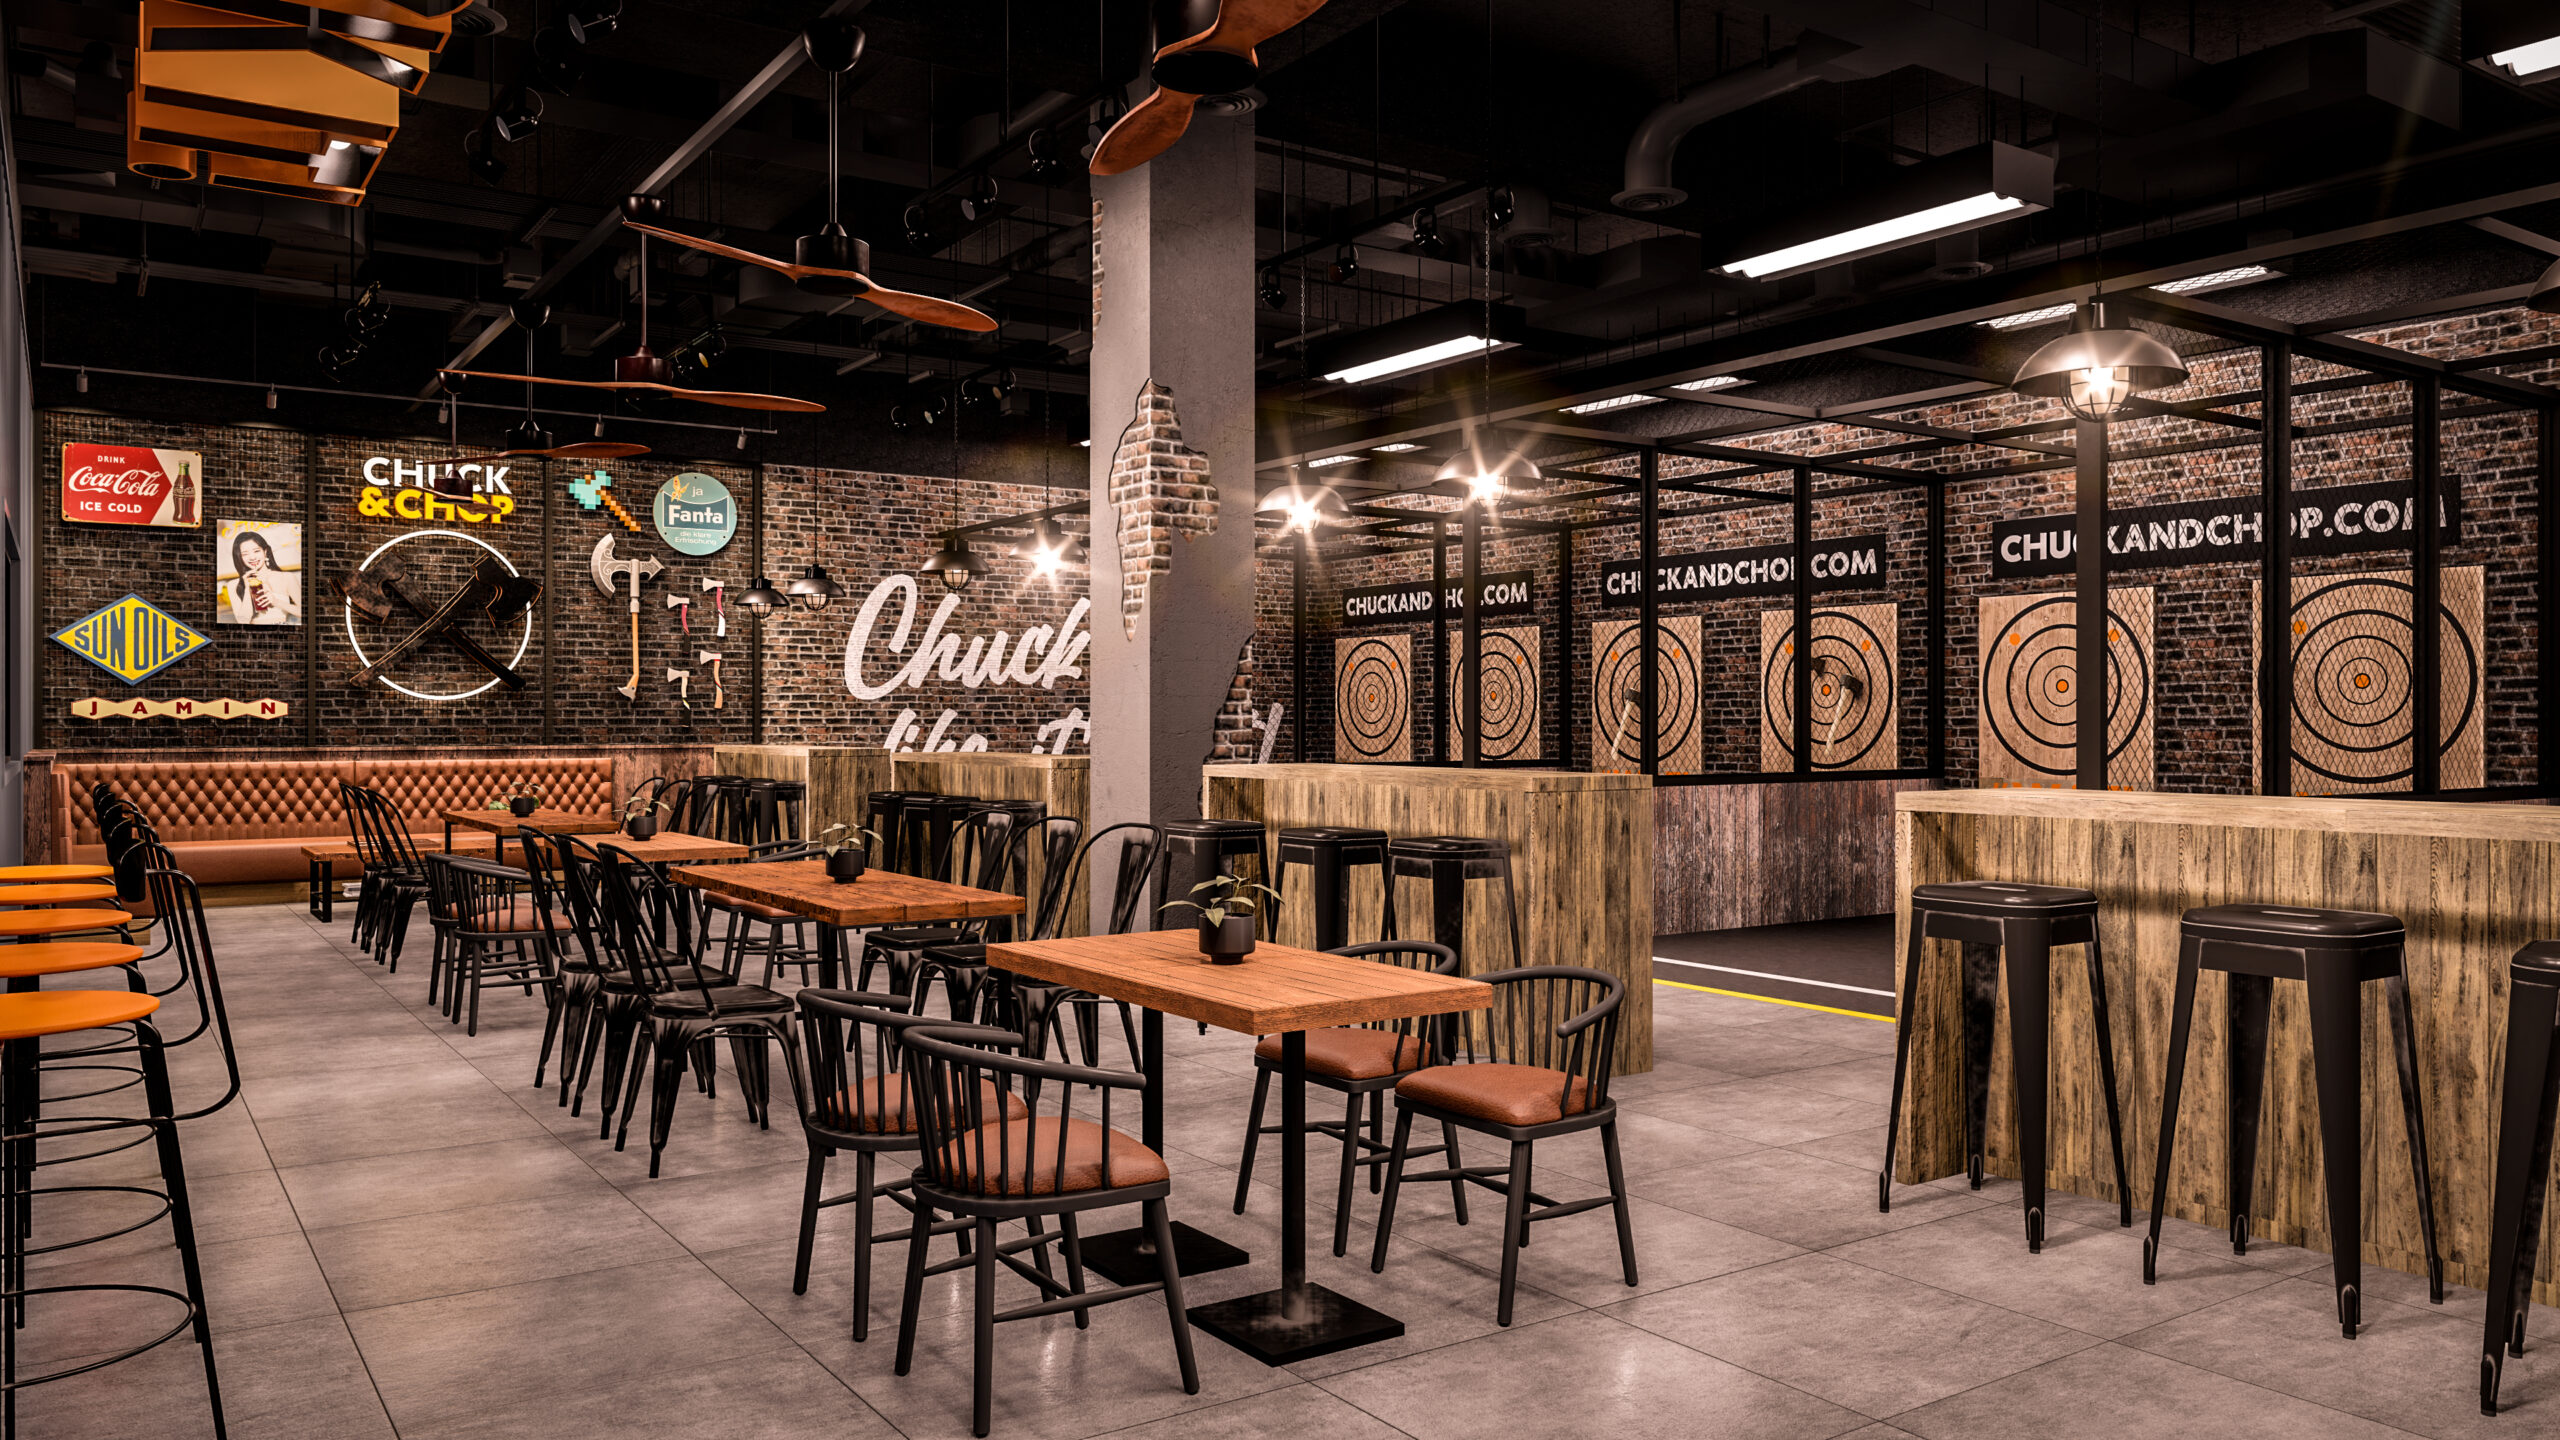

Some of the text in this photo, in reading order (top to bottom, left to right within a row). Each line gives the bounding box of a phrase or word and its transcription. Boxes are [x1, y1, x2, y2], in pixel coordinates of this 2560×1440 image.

[97, 455, 126, 464] DRINK
[68, 465, 164, 497] Coca-Cola
[691, 486, 704, 498] ja
[80, 501, 142, 514] ICE COLD
[668, 504, 724, 526] Fanta
[74, 606, 191, 671] SUN OILS
[844, 573, 1091, 700] Chuck
